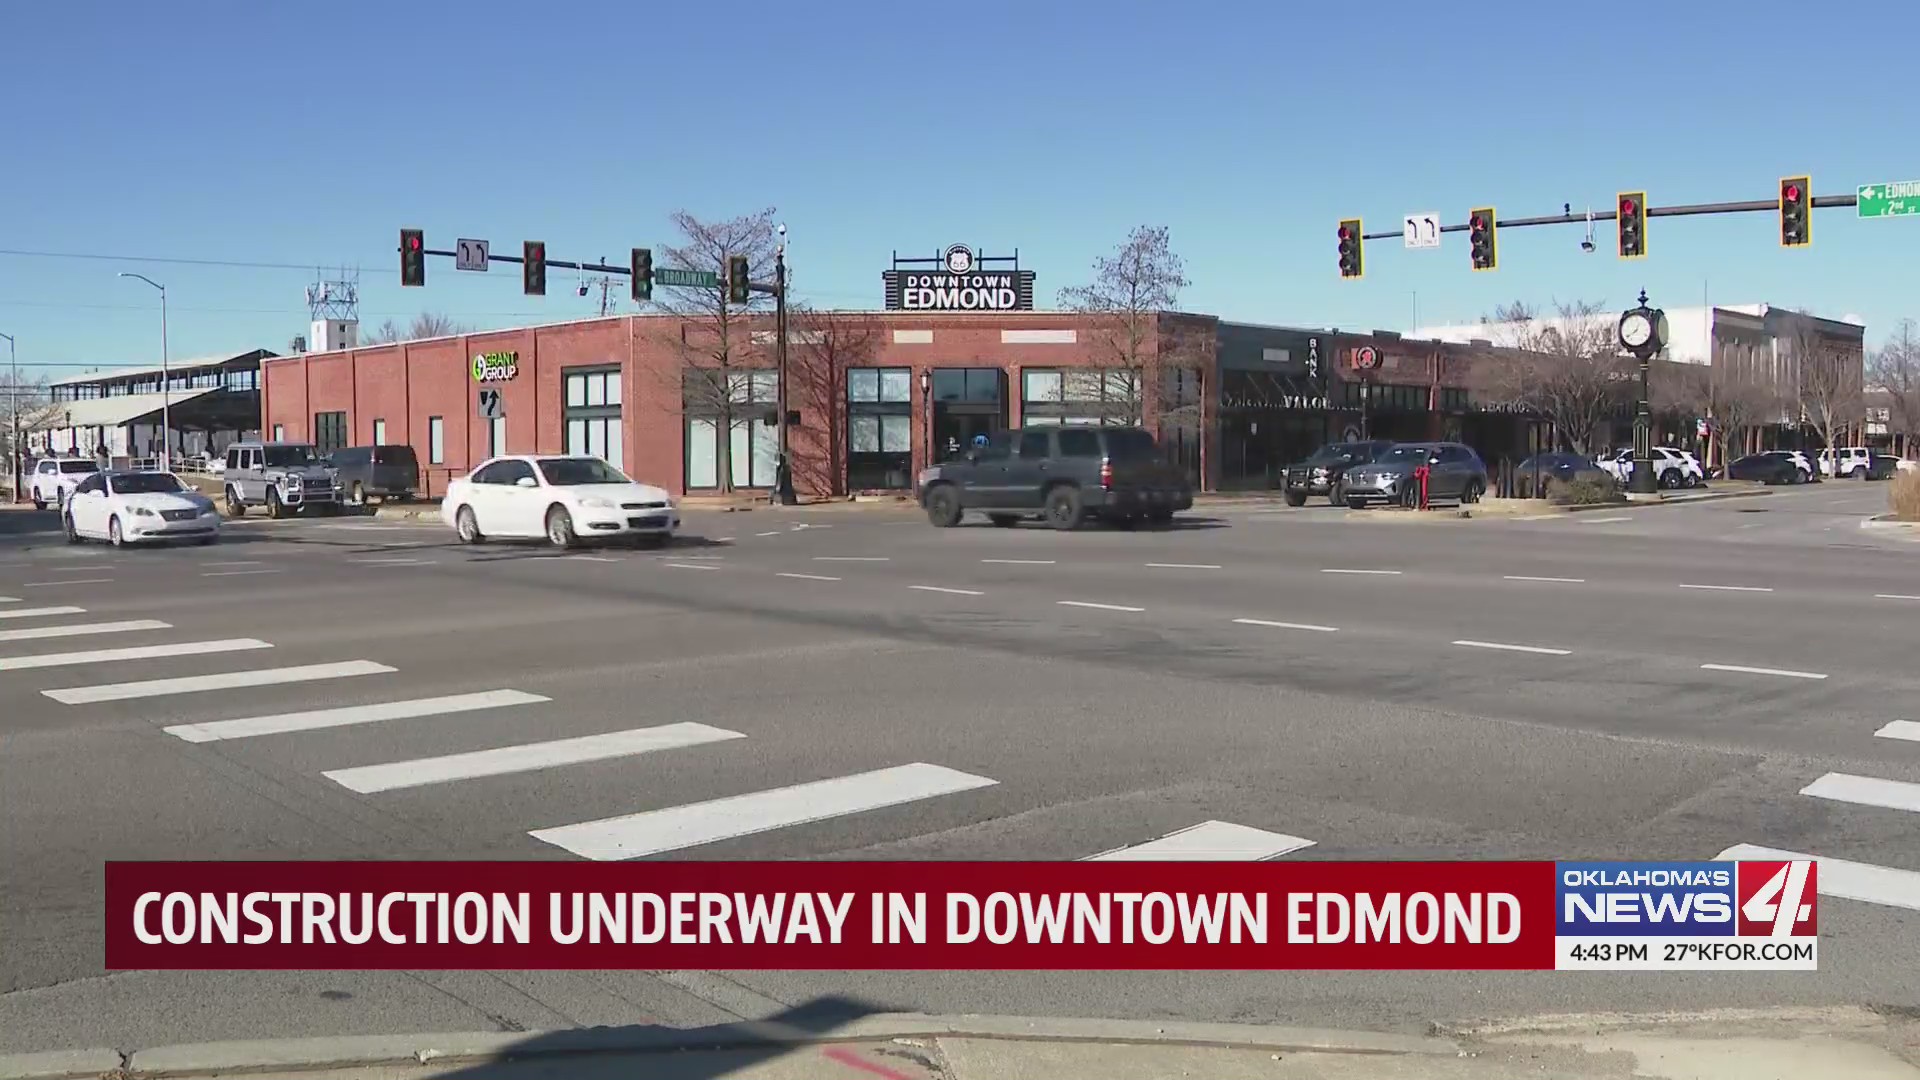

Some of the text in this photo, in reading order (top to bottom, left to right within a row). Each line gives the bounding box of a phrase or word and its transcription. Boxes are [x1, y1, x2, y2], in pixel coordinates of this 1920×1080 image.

[953, 260, 969, 269] 66
[664, 270, 707, 285] BROADWAY
[907, 275, 1011, 288] DOWNTOWN
[903, 288, 1016, 309] EDMOND
[485, 351, 515, 366] GRANT
[1309, 338, 1317, 378] BANK
[485, 365, 516, 380] GROUP
